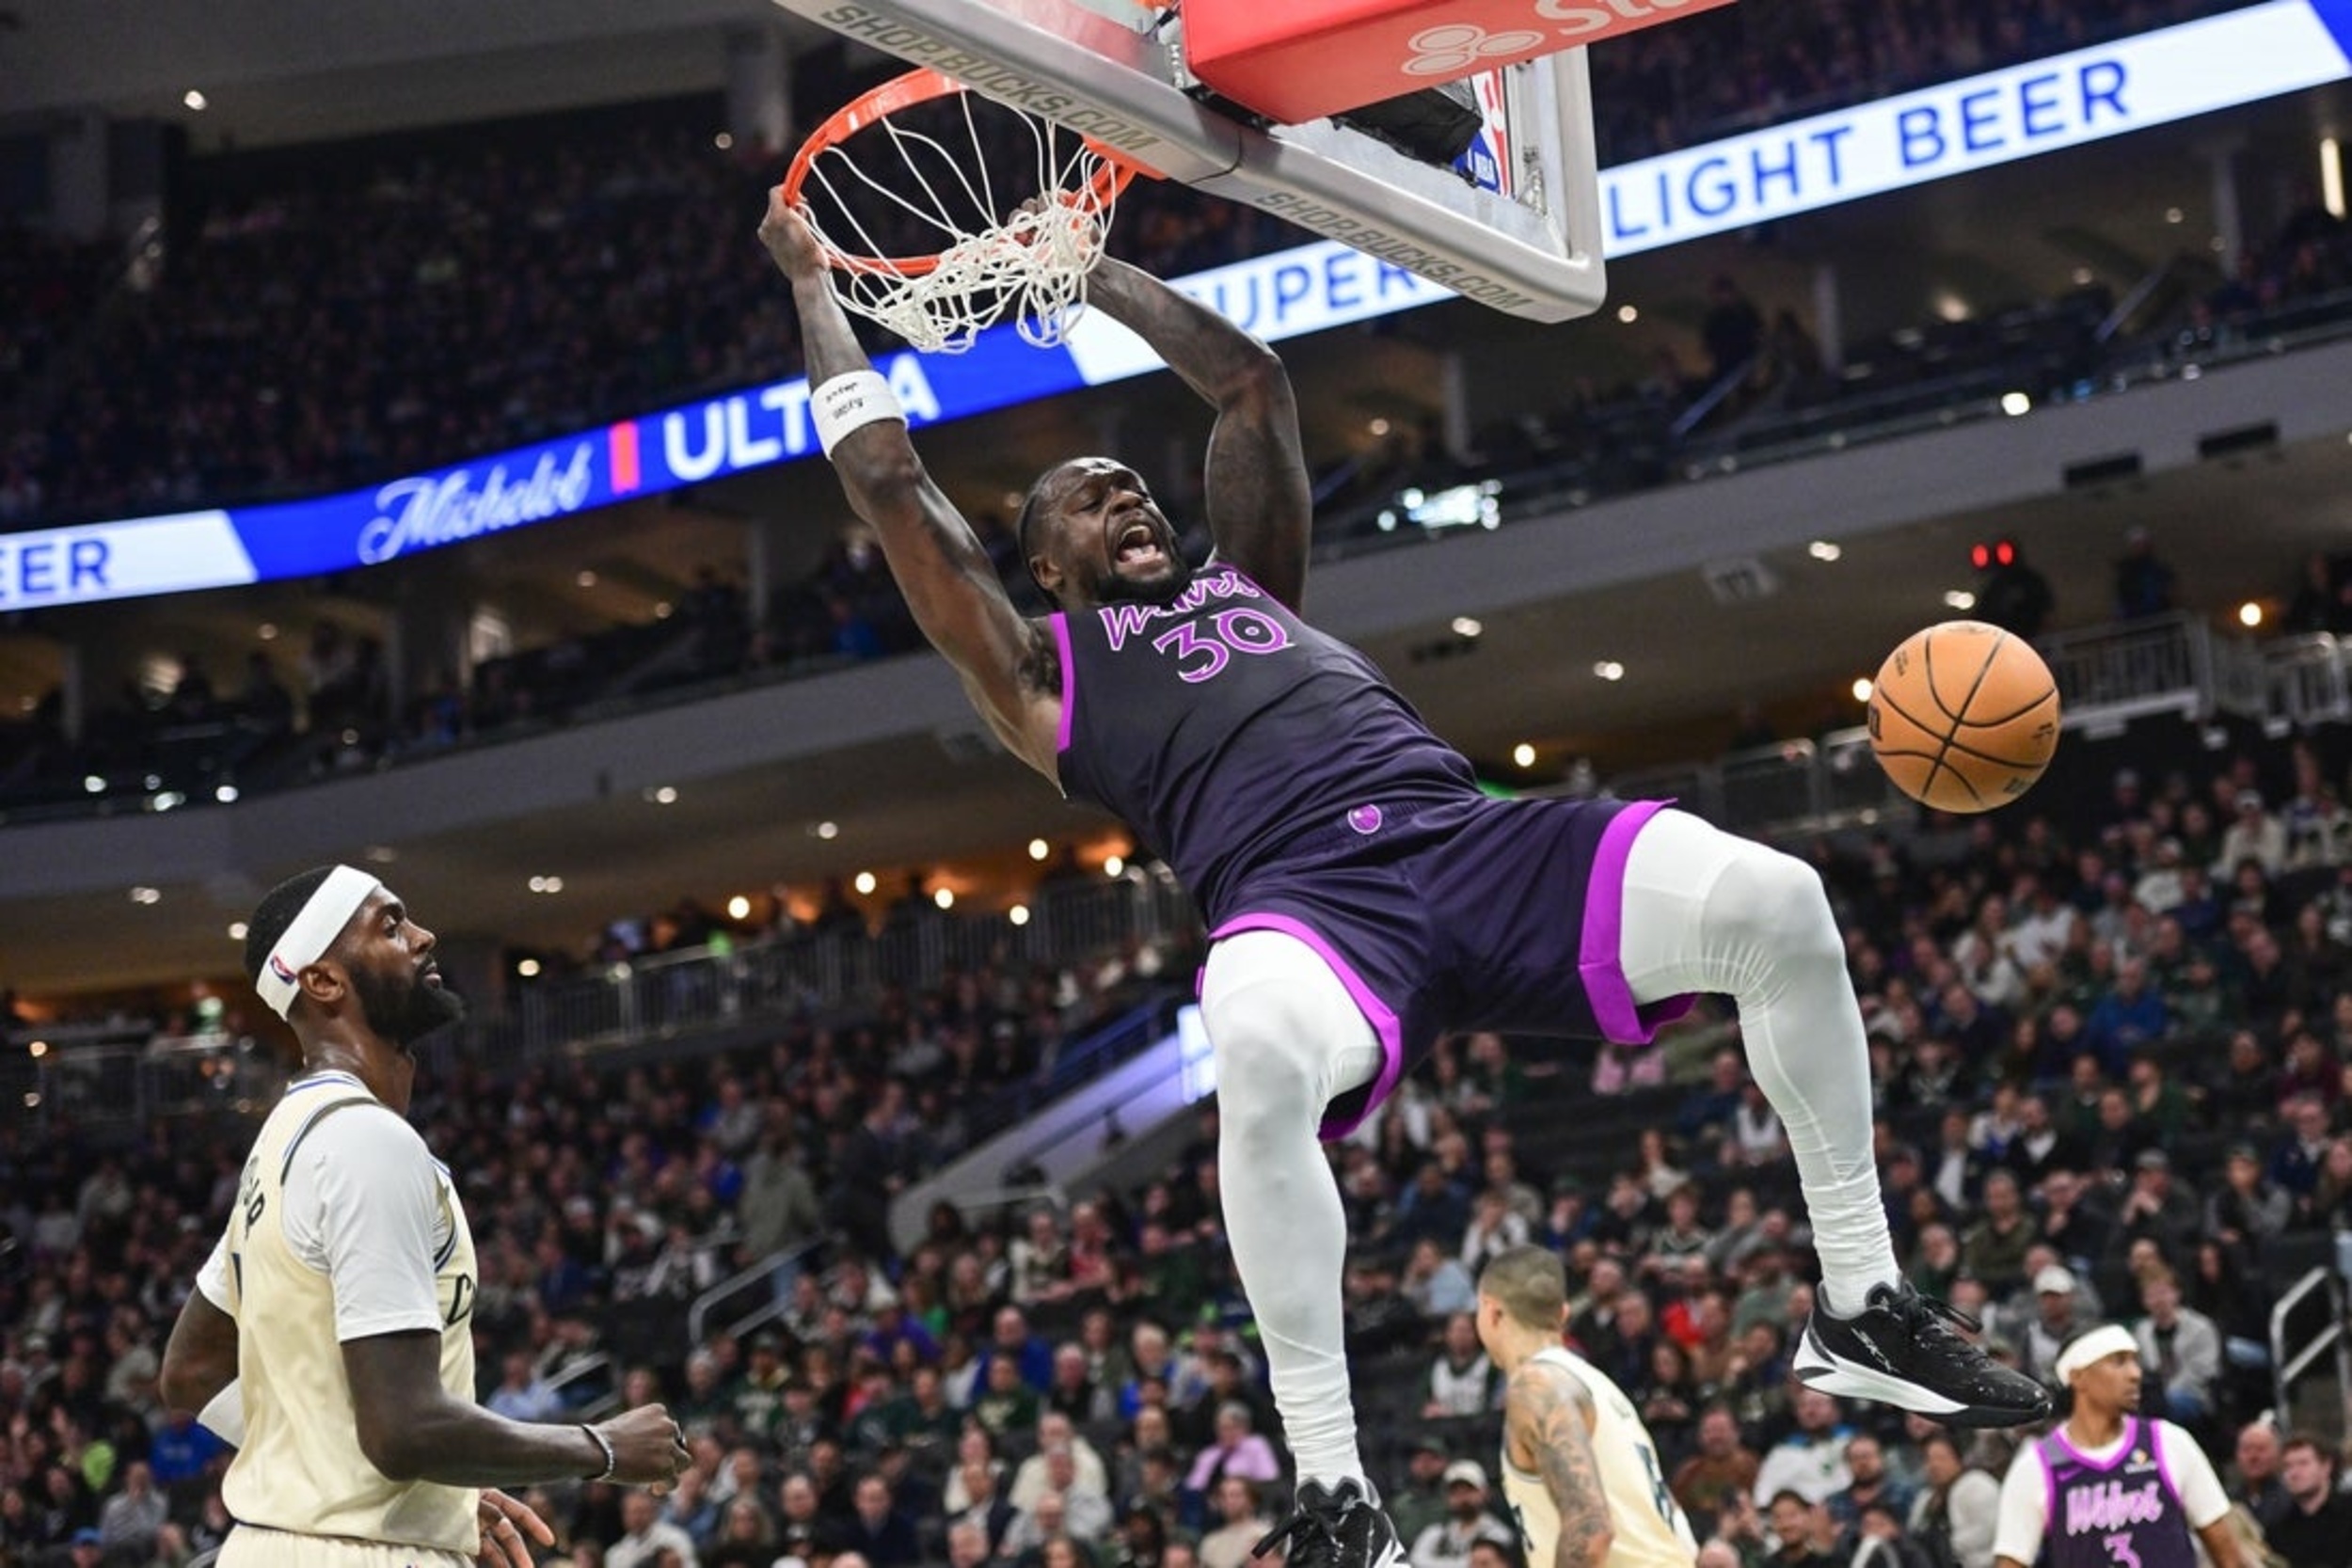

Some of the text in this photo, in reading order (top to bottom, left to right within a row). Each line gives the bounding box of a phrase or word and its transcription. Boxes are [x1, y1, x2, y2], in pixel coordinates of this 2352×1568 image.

[820, 5, 1161, 151] SHOP.BUCKS.COM
[1187, 58, 2132, 331] UPER LIGHT BEER
[1256, 191, 1535, 309] SHOP.BUCKS.COM
[0, 353, 942, 597] ER Michelob ULTA
[1151, 607, 1296, 683] 30
